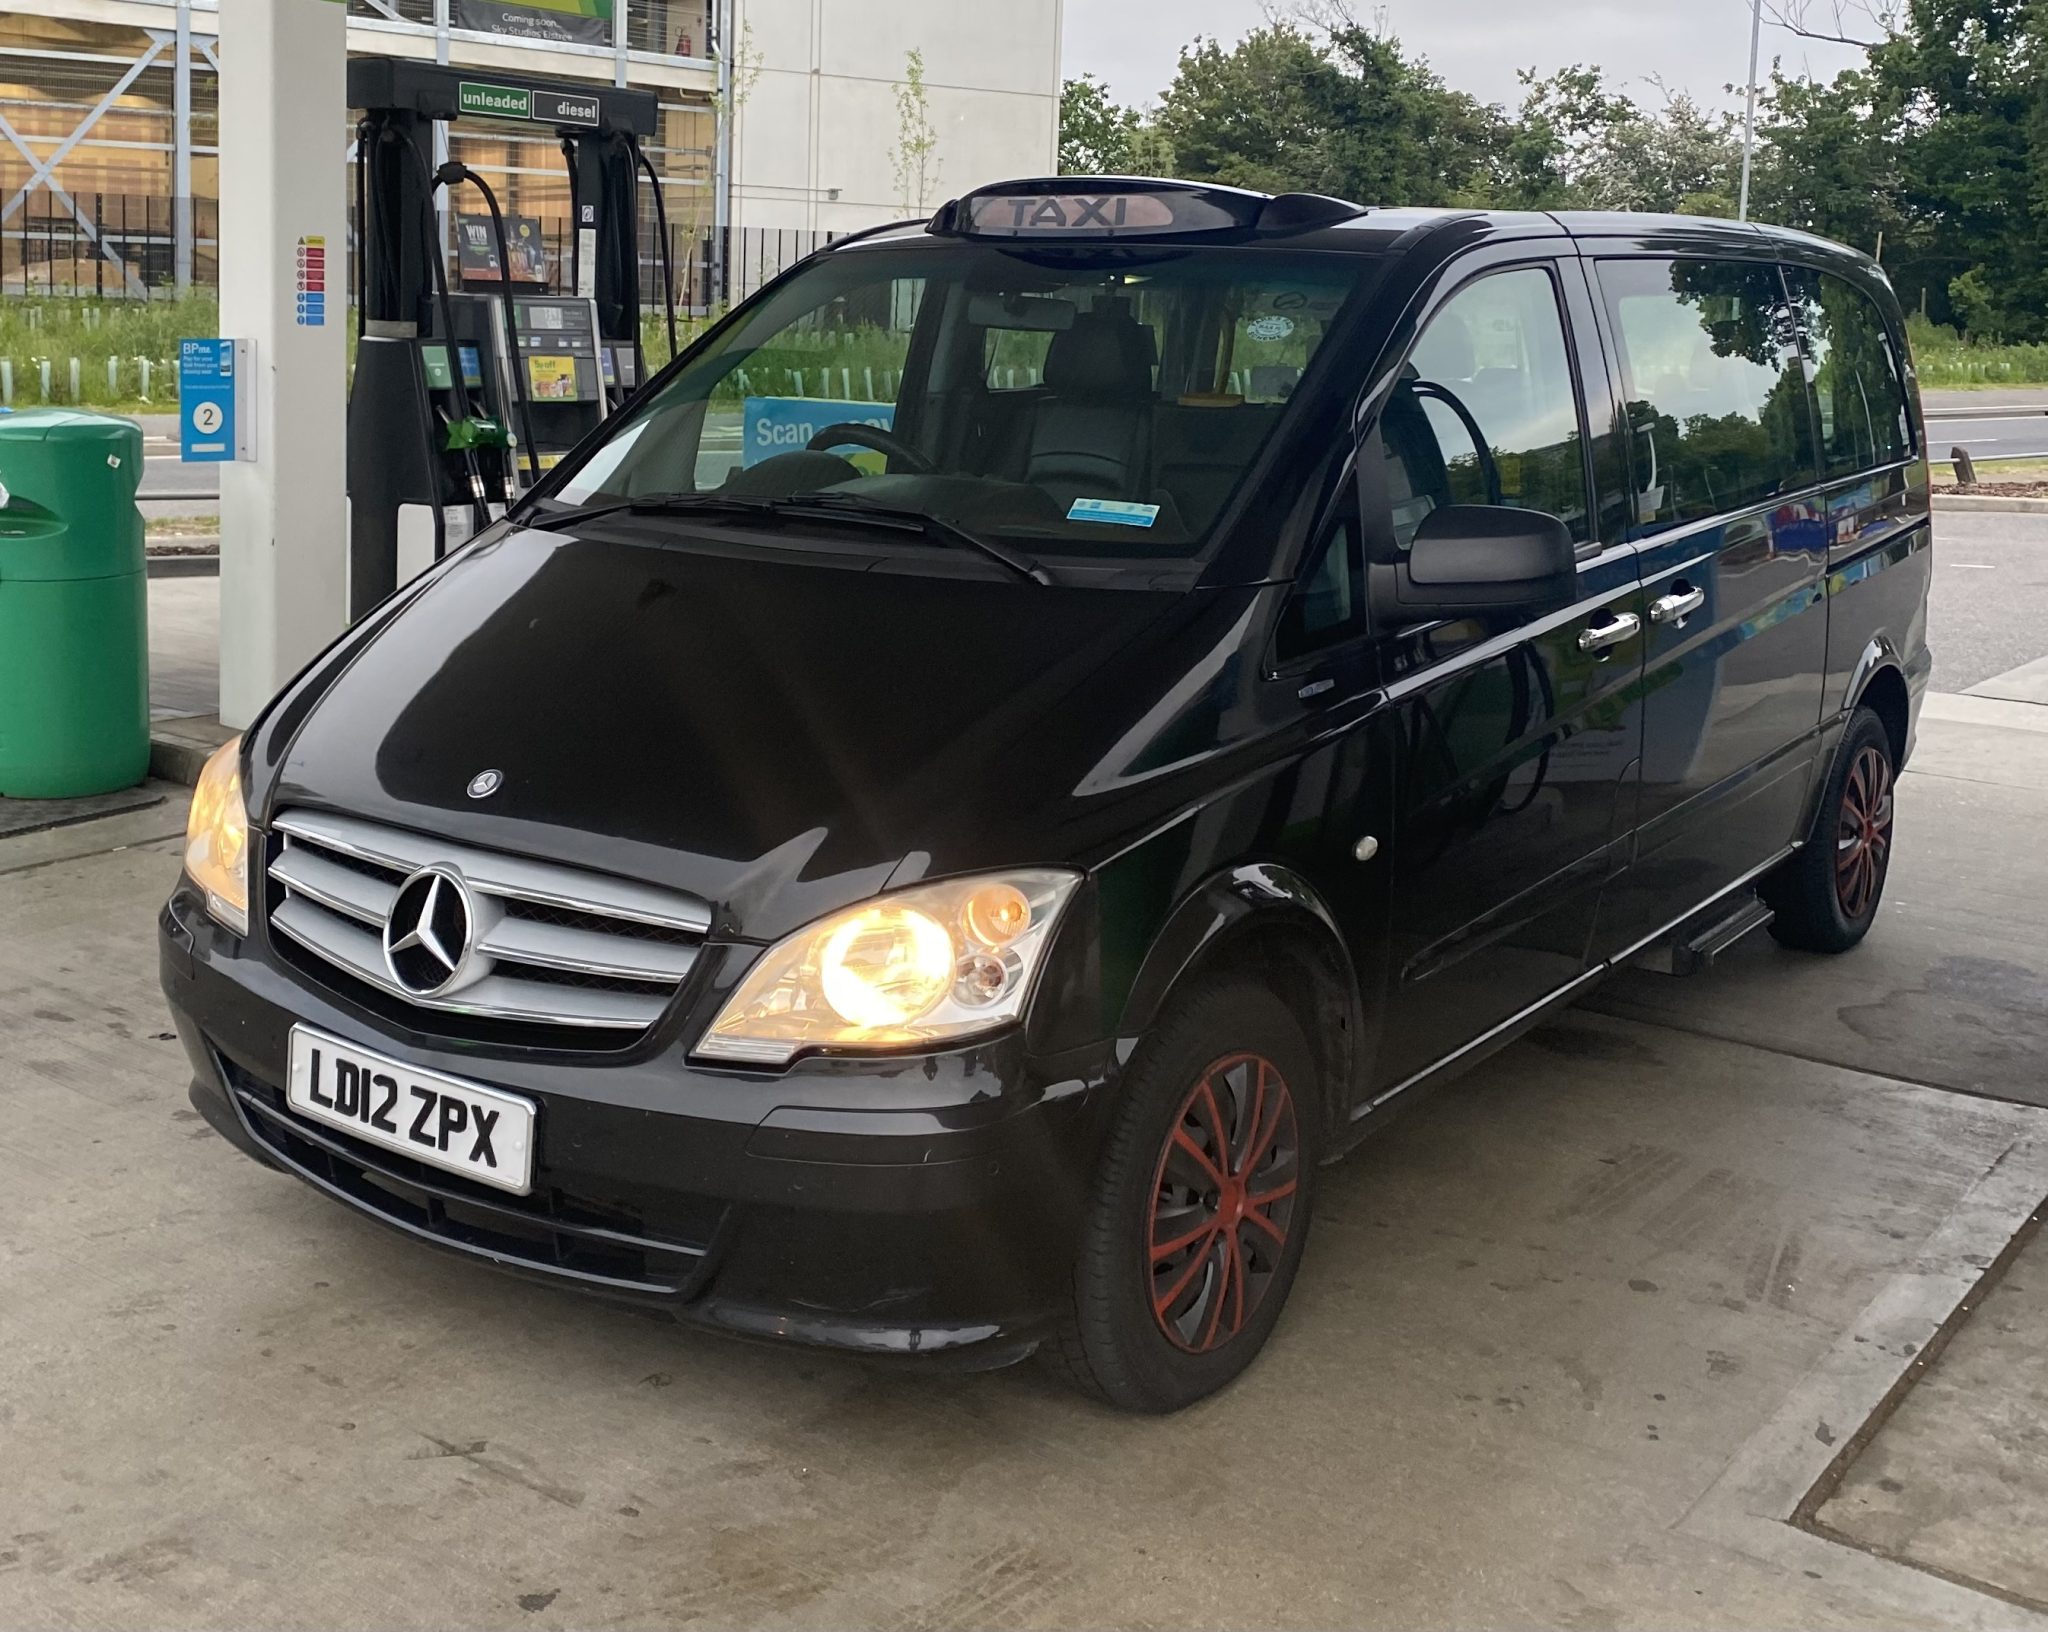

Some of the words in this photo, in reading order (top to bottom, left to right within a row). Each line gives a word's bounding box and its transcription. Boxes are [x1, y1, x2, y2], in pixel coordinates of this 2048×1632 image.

[502, 13, 535, 27] Coming
[491, 24, 507, 34] Sky
[508, 26, 541, 38] Studios
[463, 92, 527, 110] unleaded
[557, 101, 596, 119] diesel
[1008, 197, 1127, 227] TAXI
[465, 224, 488, 241] WIN
[203, 408, 214, 426] 2
[756, 417, 814, 447] Scan
[309, 1048, 398, 1134] LD12
[408, 1085, 500, 1168] ZPX
